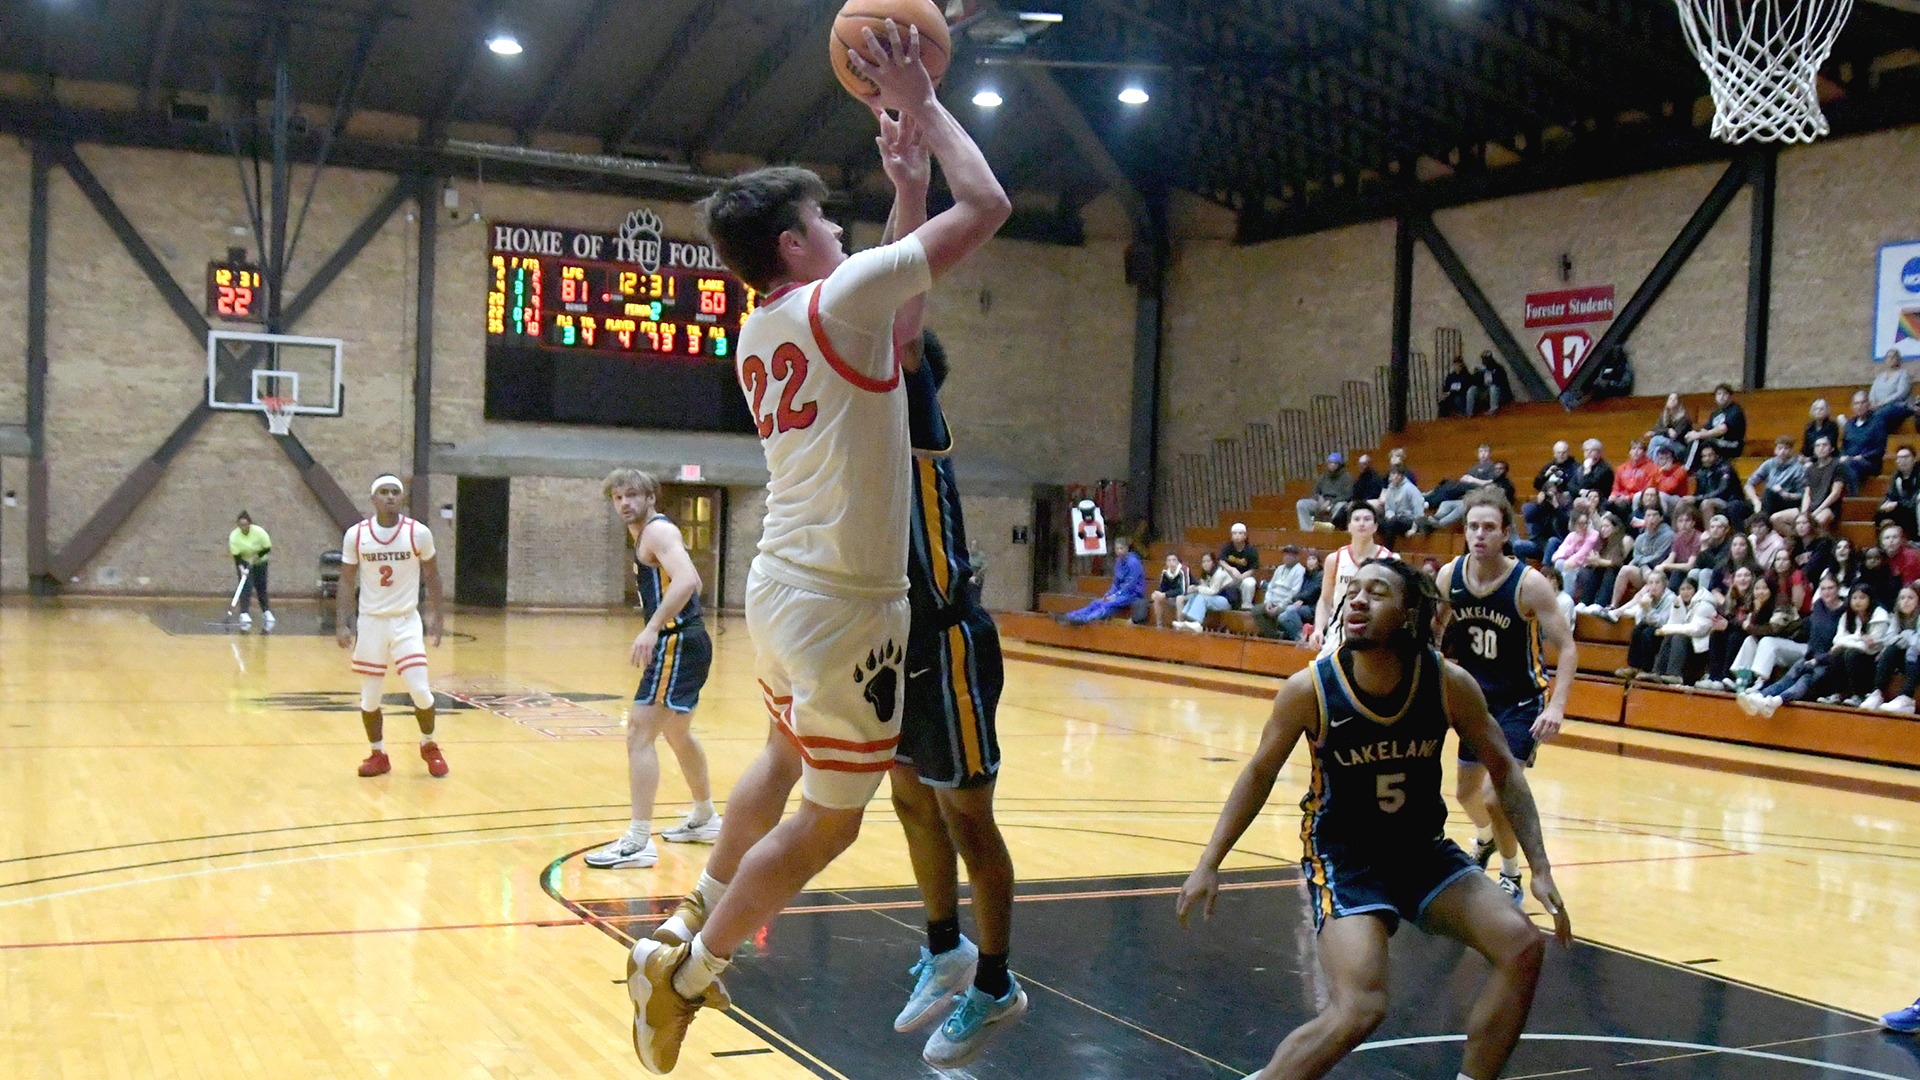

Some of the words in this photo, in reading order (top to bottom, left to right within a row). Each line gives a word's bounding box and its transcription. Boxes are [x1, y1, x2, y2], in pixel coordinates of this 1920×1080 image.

[494, 226, 563, 255] HOME
[573, 233, 604, 258] OF
[612, 236, 660, 263] THE
[562, 266, 584, 280] LFC
[618, 272, 675, 297] 12:31
[561, 279, 589, 303] 81
[698, 278, 725, 292] LAKE
[217, 287, 253, 315] 22
[649, 301, 662, 321] 2
[700, 290, 727, 315] 60
[1526, 302, 1566, 320] Forester
[1568, 296, 1613, 316] Students
[556, 314, 573, 328] FLS
[604, 318, 636, 332] PLAYER
[640, 321, 657, 333] PTS
[660, 322, 677, 335] FLS
[708, 326, 725, 339] FLS
[581, 328, 595, 346] 4
[618, 330, 631, 349] 4
[661, 332, 674, 353] 3
[687, 334, 700, 354] 3
[742, 341, 819, 440] 22
[361, 551, 411, 561] FORESTERS
[379, 564, 394, 587] 2
[1451, 605, 1511, 629] LAKELAND
[1468, 625, 1498, 660] 30
[1376, 772, 1406, 814] 5
